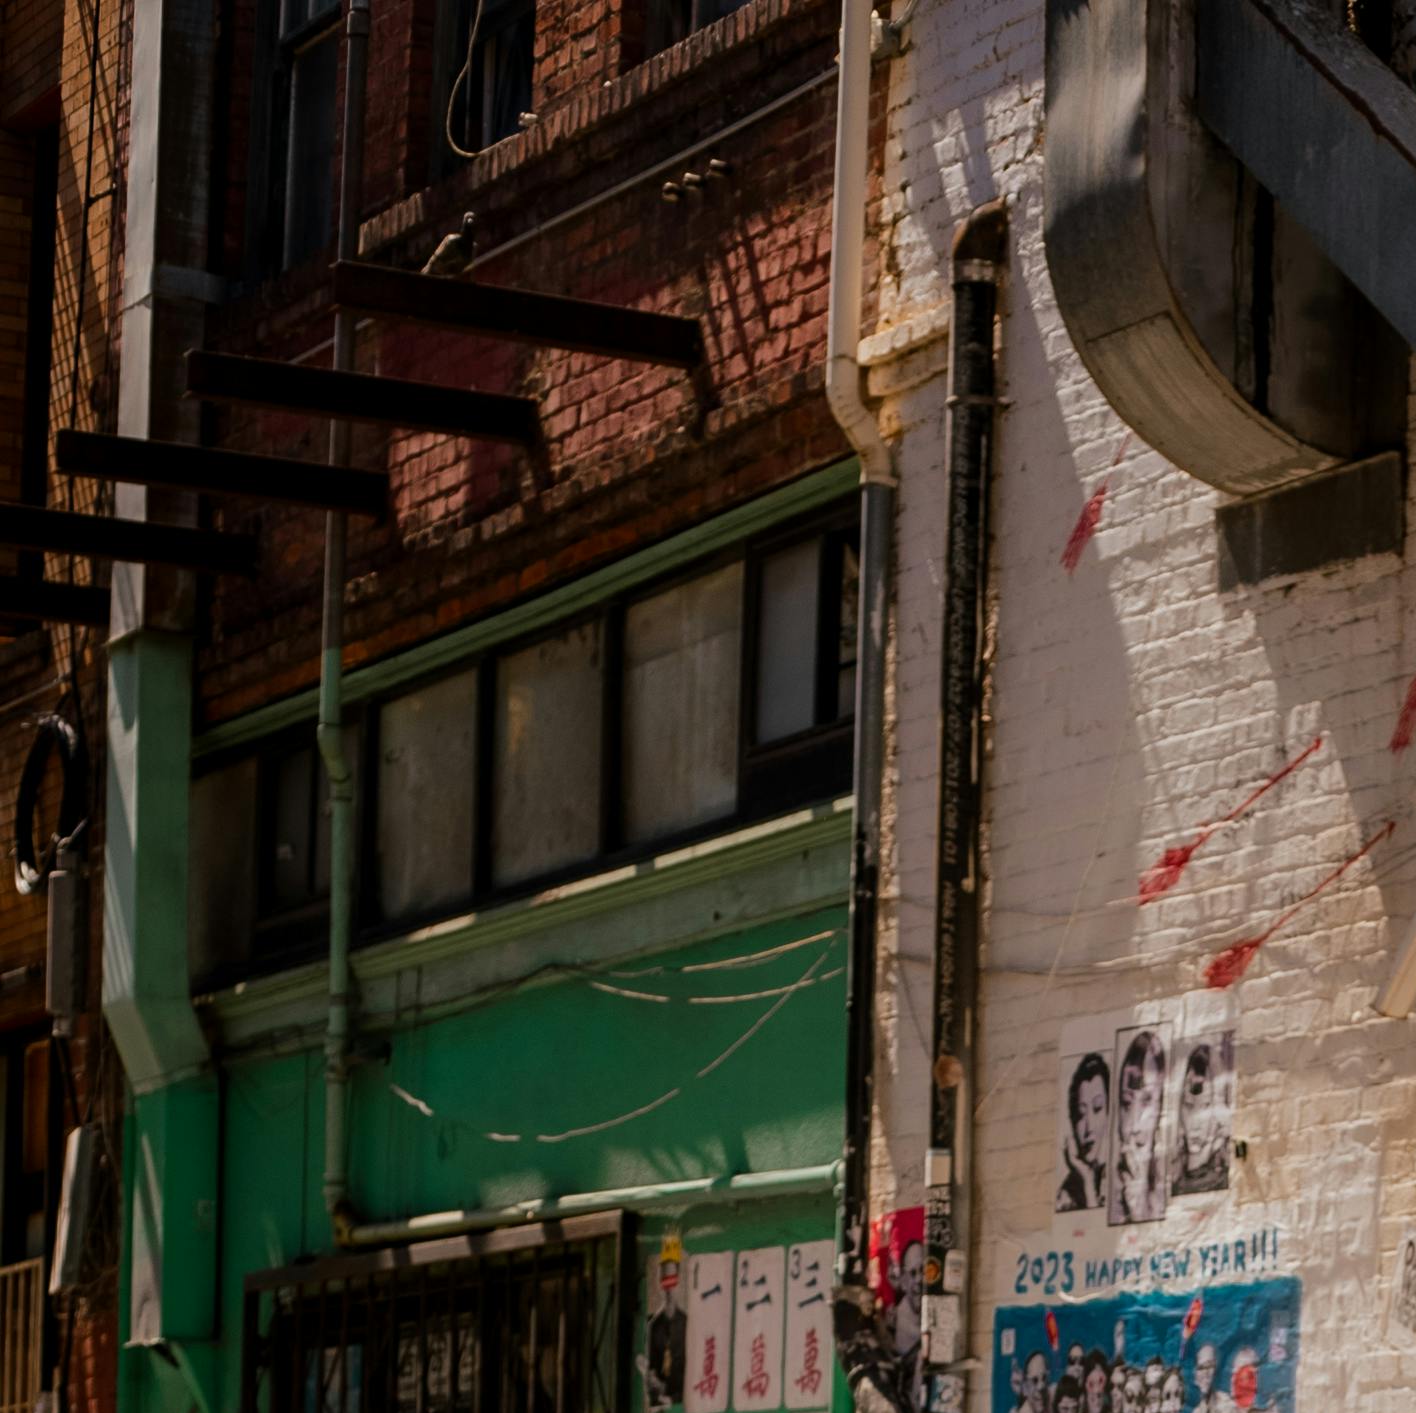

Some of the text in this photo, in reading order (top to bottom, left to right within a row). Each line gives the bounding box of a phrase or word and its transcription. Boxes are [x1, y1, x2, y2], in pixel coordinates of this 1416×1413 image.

[1014, 1251, 1075, 1295] 2023
[1085, 1256, 1143, 1289] HAPPY
[1150, 1249, 1190, 1280] NEW
